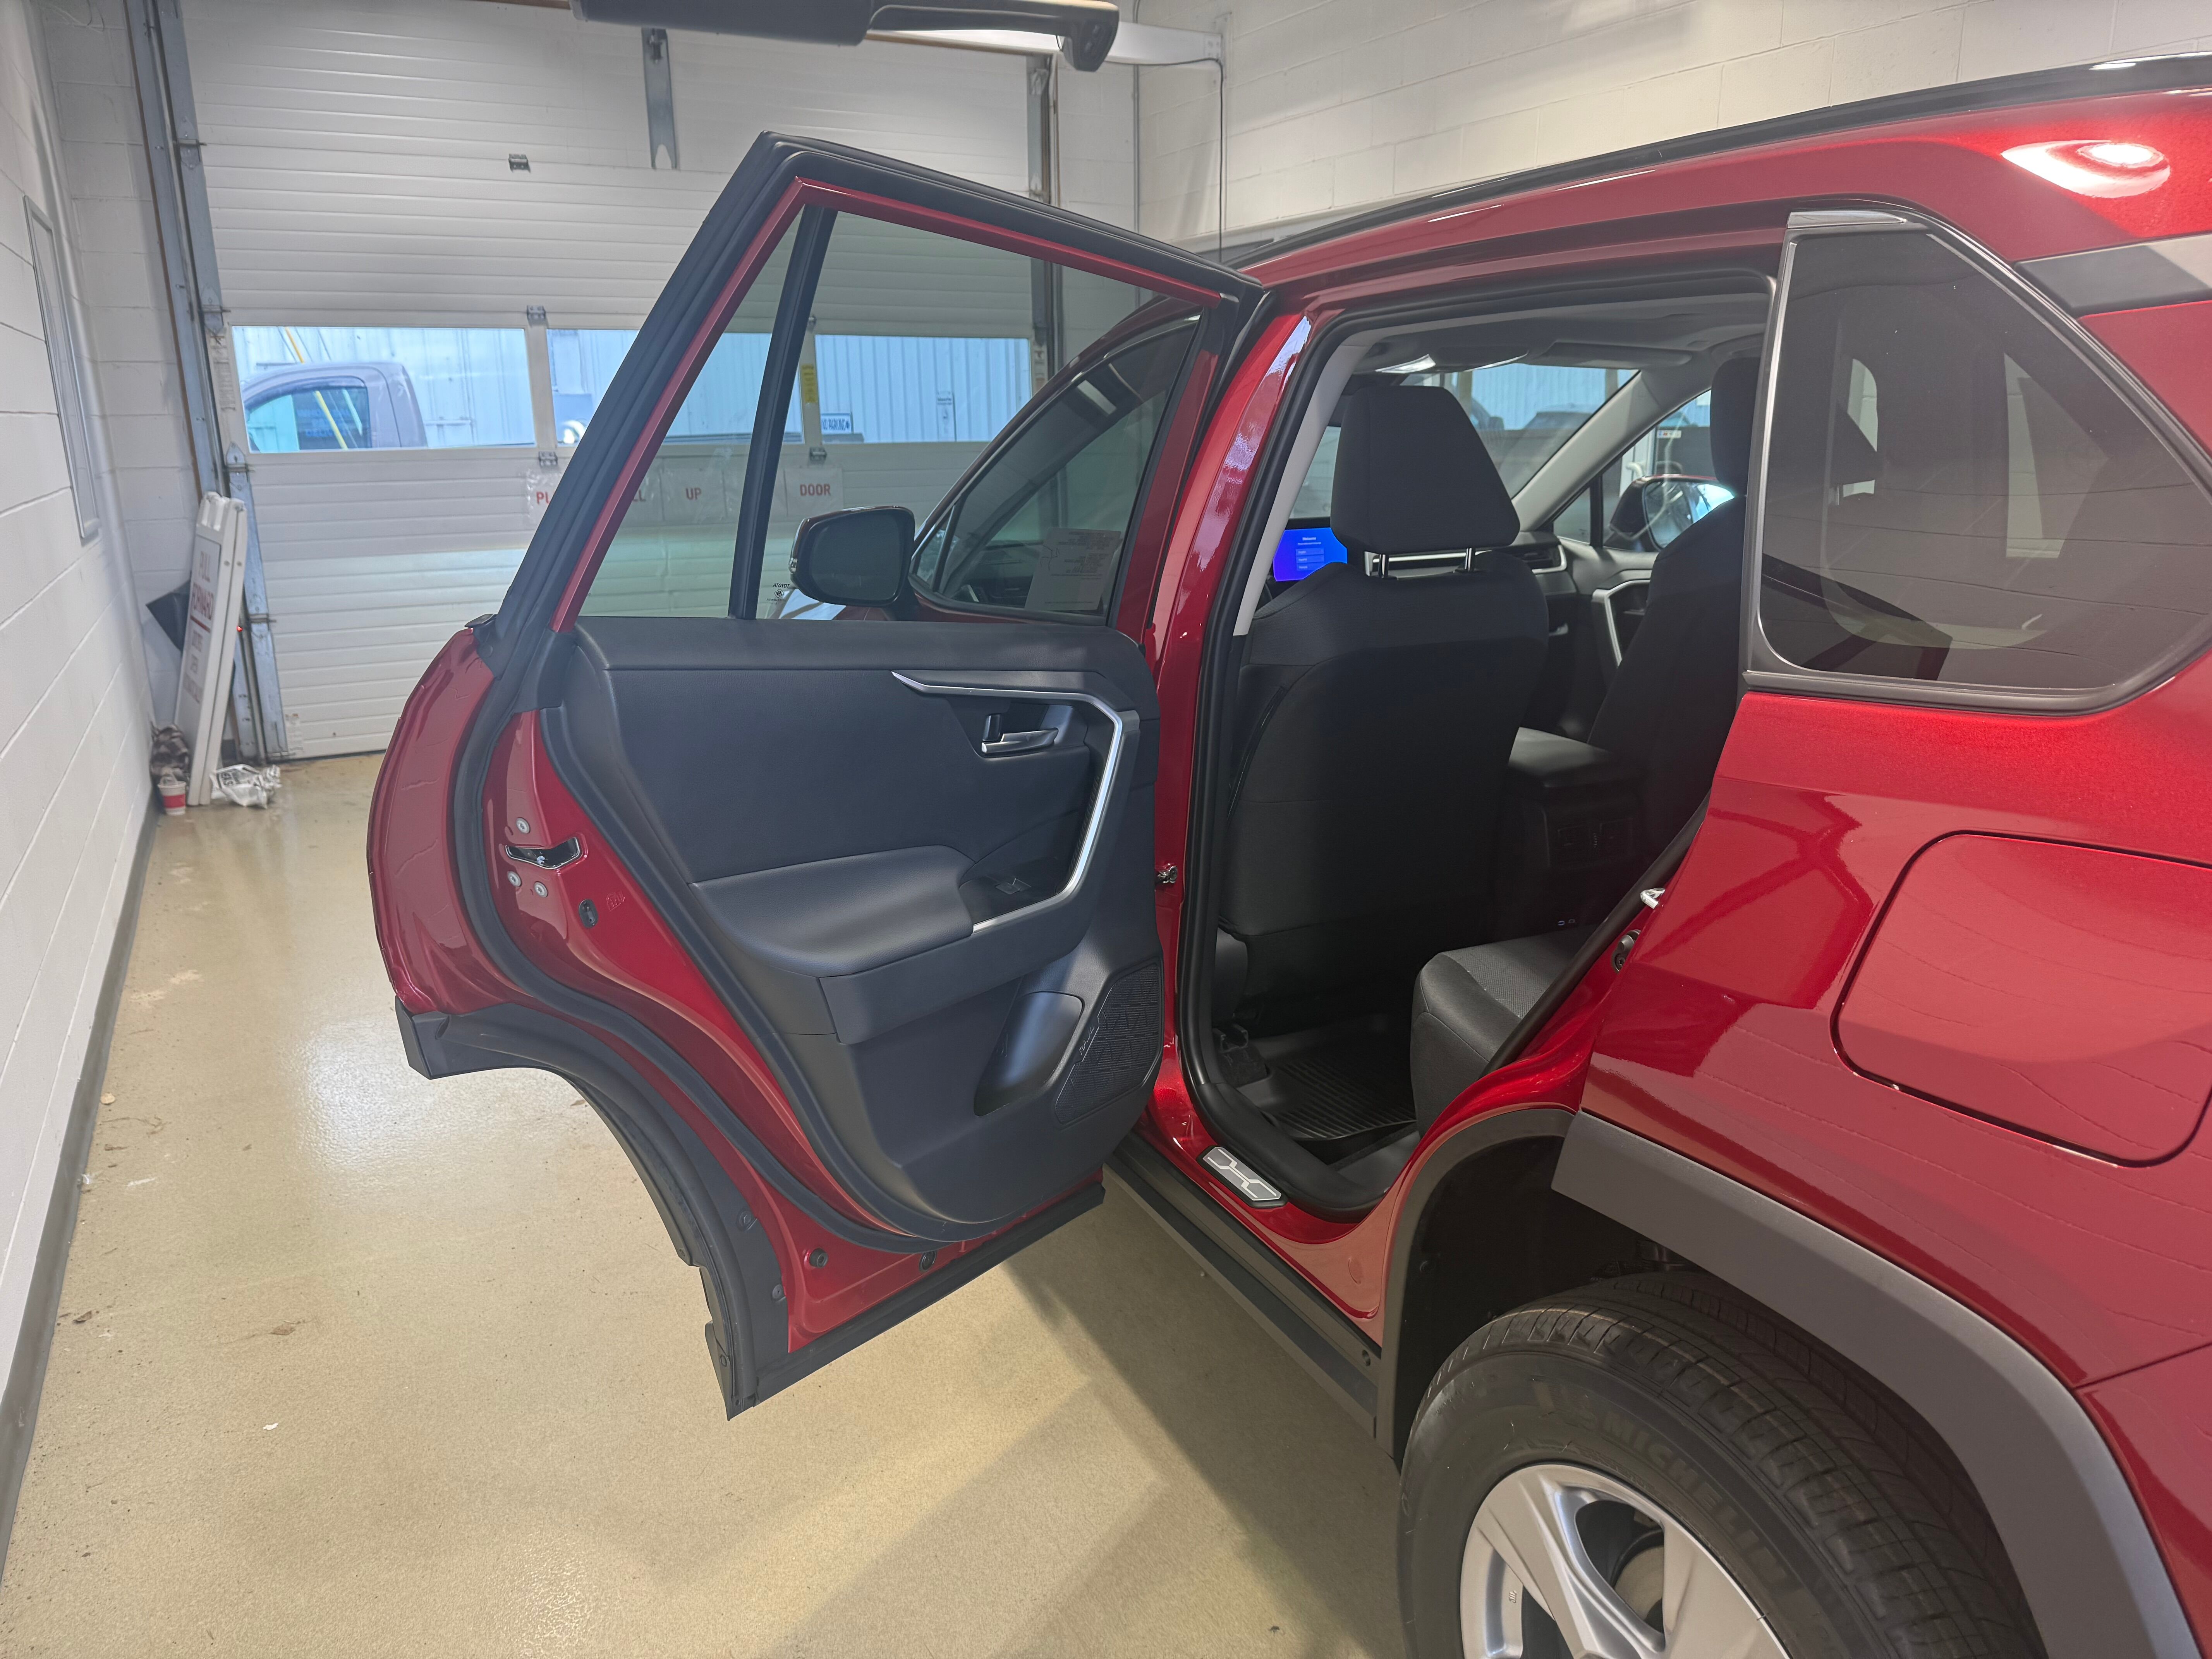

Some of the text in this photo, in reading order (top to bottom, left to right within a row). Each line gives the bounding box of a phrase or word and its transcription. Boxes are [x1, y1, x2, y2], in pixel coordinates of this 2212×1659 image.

[686, 484, 831, 500] UP DOOR
[1603, 1410, 1788, 1584] MICHELIN
